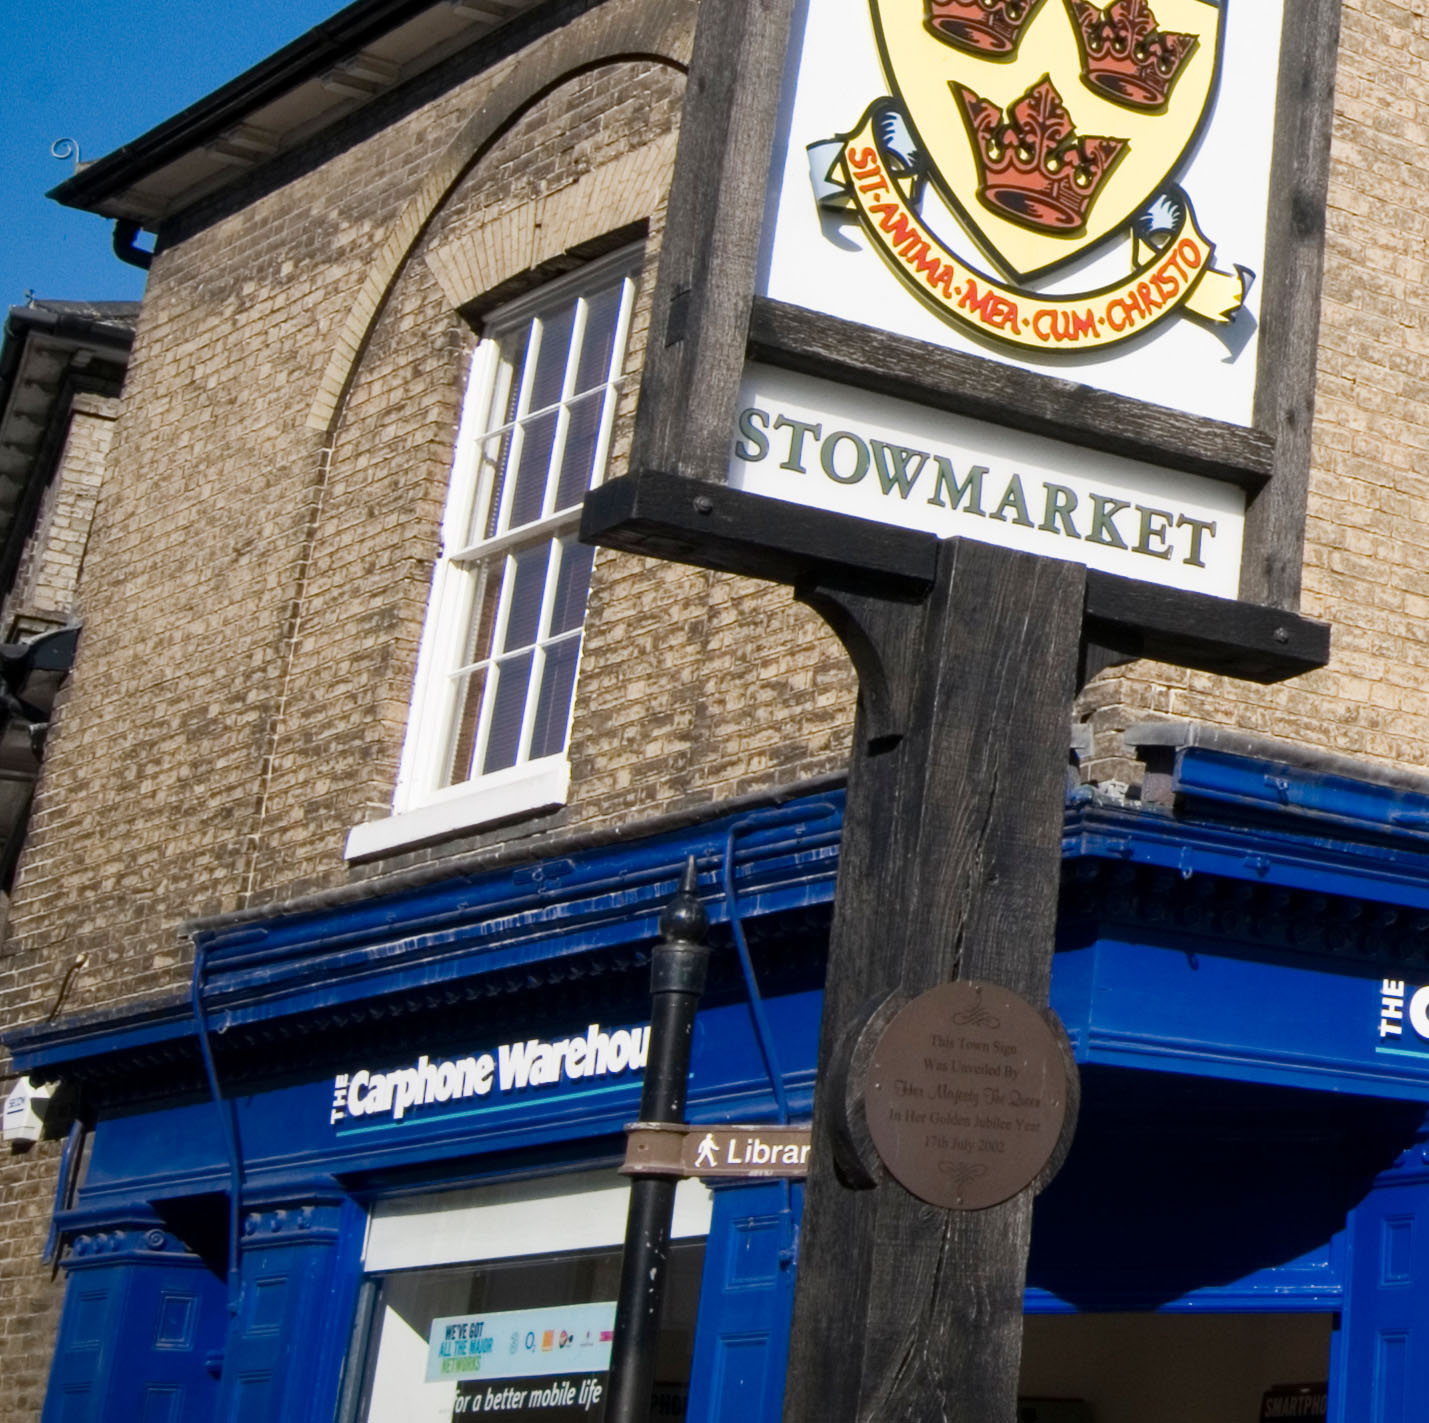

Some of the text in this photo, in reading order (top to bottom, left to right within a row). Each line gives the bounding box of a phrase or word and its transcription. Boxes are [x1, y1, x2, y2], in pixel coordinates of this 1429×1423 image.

[848, 146, 1202, 342] SIT ANIMA MEA CUM CHRISTO
[734, 408, 1217, 568] STOWMARKET
[1381, 978, 1405, 1037] THE
[347, 1024, 652, 1119] Carphone Warehou
[330, 1073, 349, 1125] THE
[727, 1138, 811, 1164] Librar
[453, 1339, 468, 1356] THE
[469, 1321, 485, 1338] GOT
[472, 1394, 483, 1412] a
[484, 1386, 529, 1411] better
[528, 1381, 575, 1408] mobile
[578, 1378, 602, 1412] life
